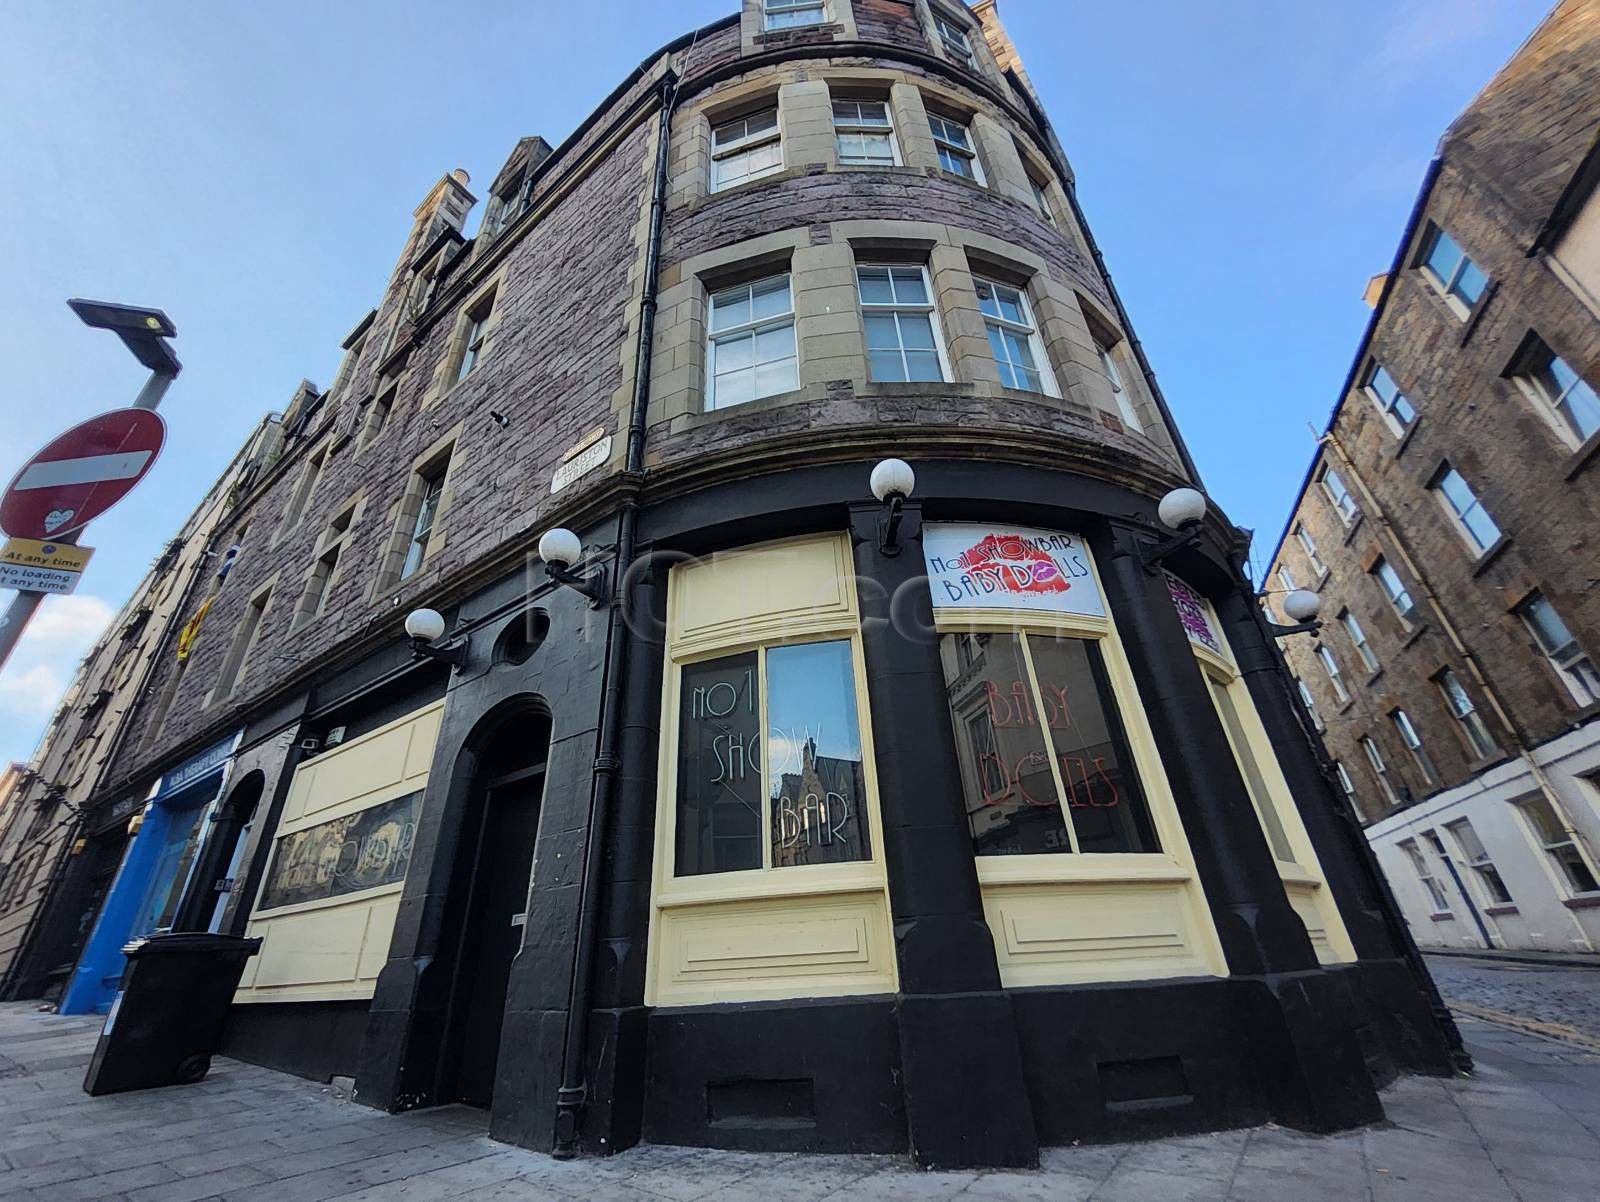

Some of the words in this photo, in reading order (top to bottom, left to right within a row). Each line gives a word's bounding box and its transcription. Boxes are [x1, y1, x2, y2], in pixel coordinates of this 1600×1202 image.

[5, 551, 22, 560] At
[25, 555, 49, 565] any
[52, 557, 81, 568] time
[0, 566, 18, 576] No
[22, 569, 70, 583] loading
[10, 578, 34, 588] any
[38, 581, 67, 591] time
[942, 567, 1008, 602] BABY
[710, 721, 822, 783] SHOW
[780, 791, 849, 849] BAR
